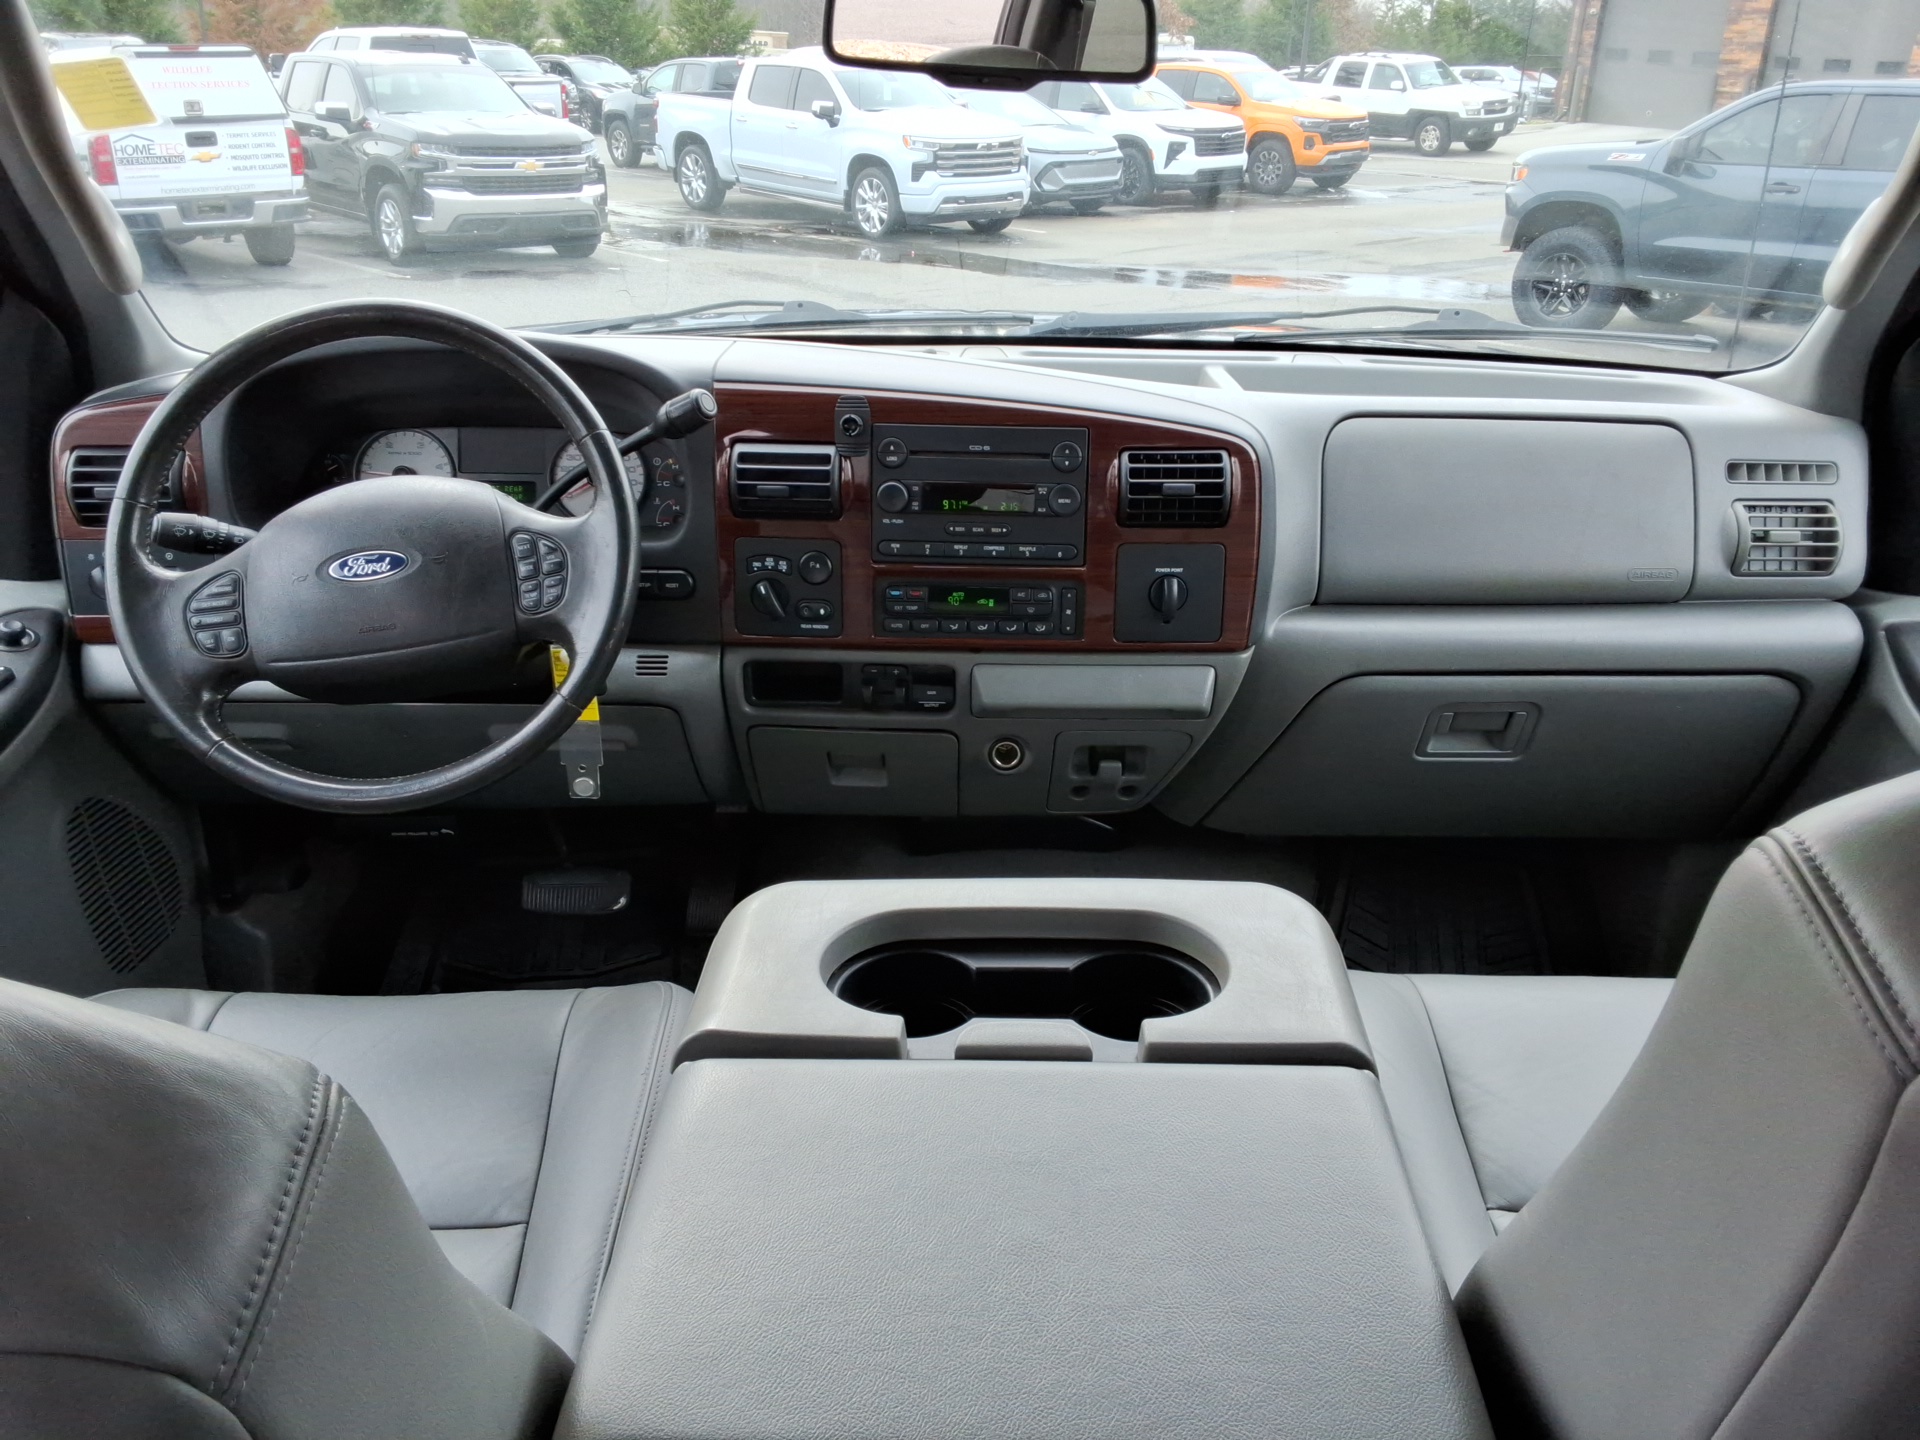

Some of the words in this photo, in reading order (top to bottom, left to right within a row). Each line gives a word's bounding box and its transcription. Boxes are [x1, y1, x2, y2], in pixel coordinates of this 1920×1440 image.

[162, 66, 213, 74] WILDLIFE
[151, 81, 198, 89] TECTION
[200, 80, 251, 89] SERVICES
[115, 155, 186, 166] EXTERMINATING
[343, 554, 391, 577] Ford
[1631, 570, 1674, 579] AIRBAG
